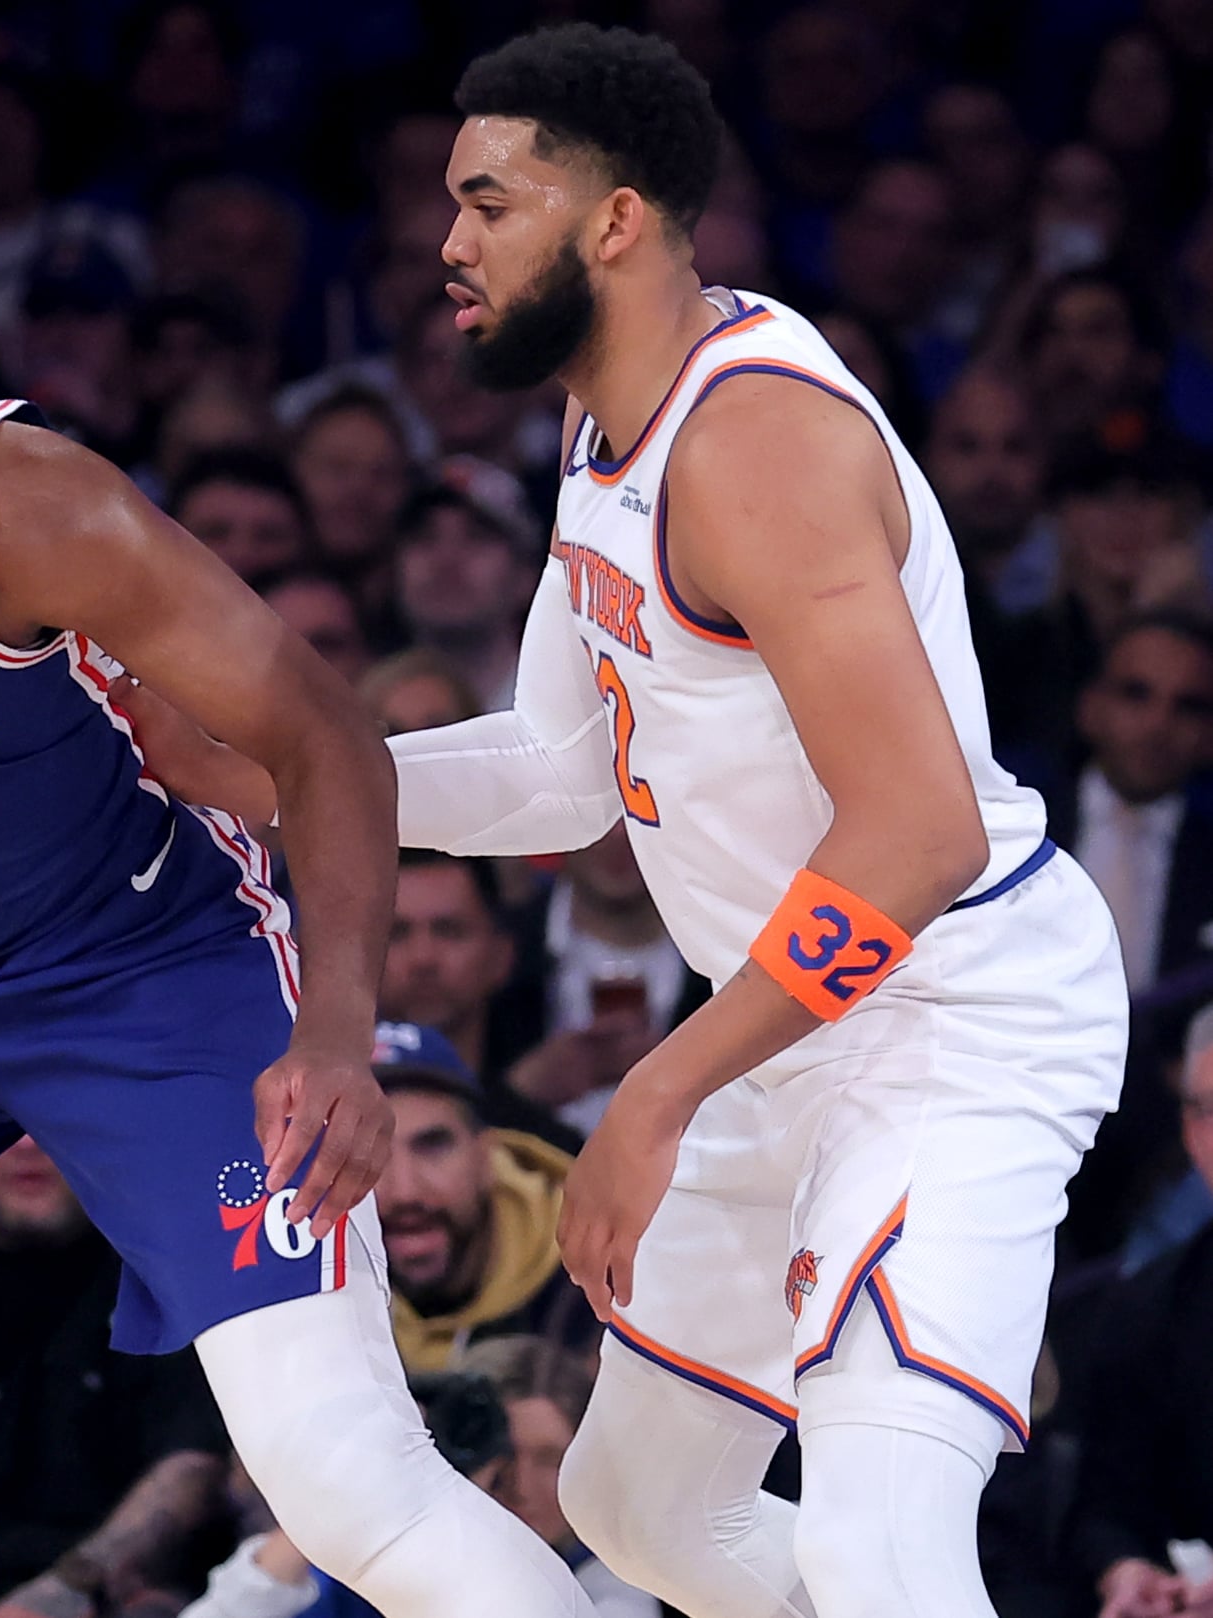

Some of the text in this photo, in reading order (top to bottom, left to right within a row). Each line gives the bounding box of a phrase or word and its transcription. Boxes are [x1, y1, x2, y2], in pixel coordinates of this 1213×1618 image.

[585, 547, 654, 661] YORK
[580, 634, 661, 829] 2
[788, 904, 893, 1001] 32
[219, 1188, 317, 1271] 76
